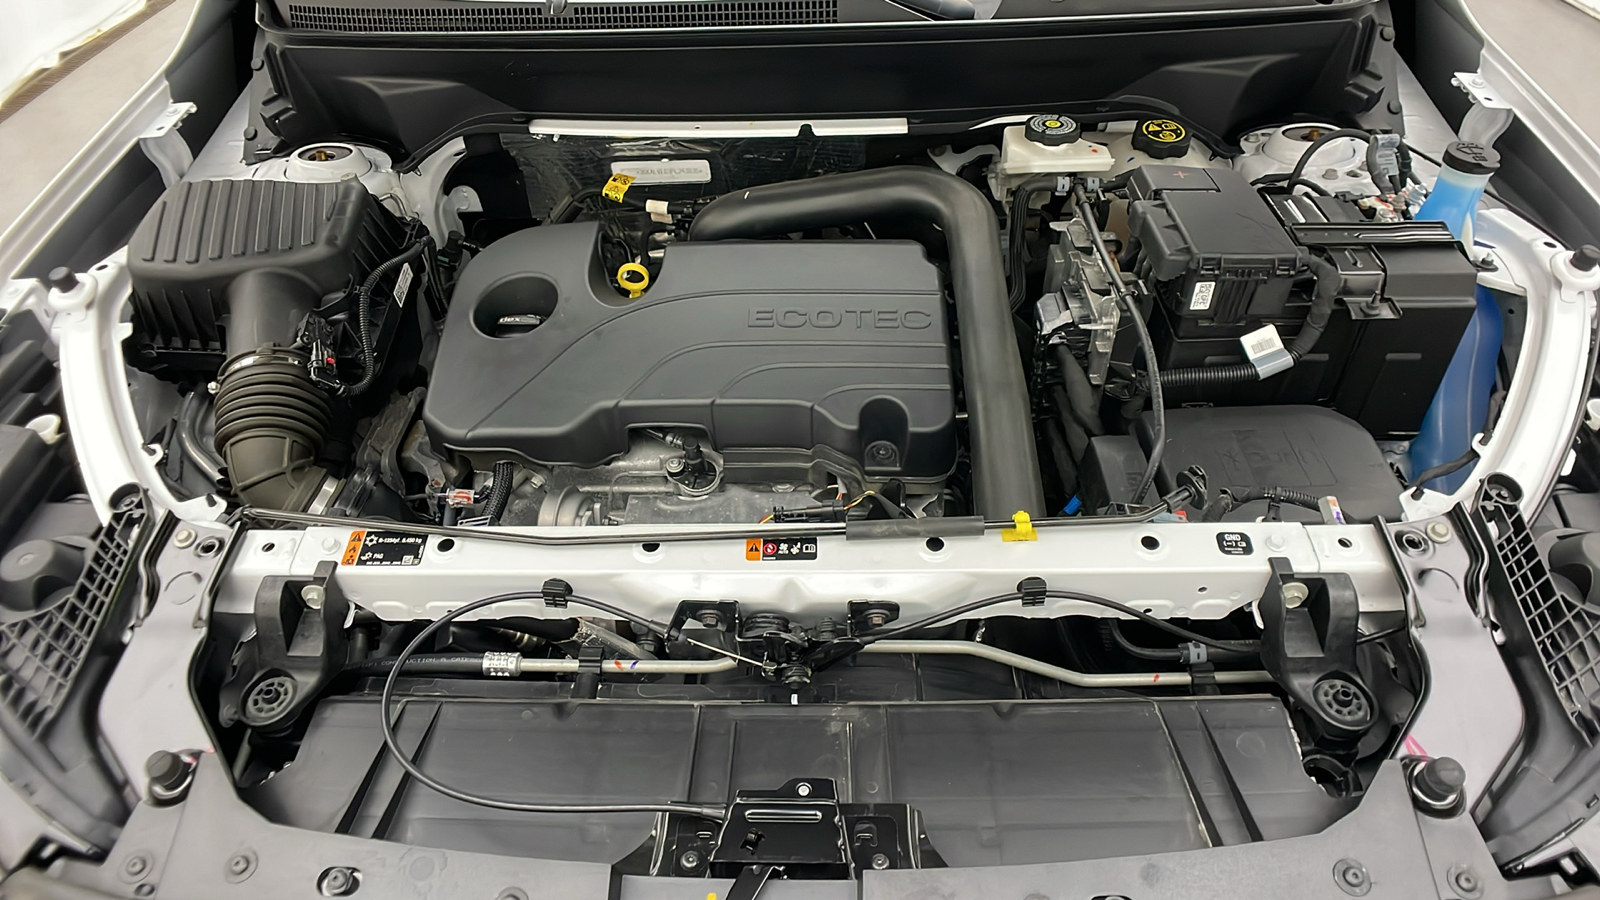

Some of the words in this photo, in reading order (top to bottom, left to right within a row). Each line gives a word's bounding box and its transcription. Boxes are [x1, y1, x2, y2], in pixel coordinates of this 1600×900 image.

[747, 307, 932, 330] ECOTEC
[1224, 533, 1241, 541] GND
[381, 657, 436, 665] CONUCTION
